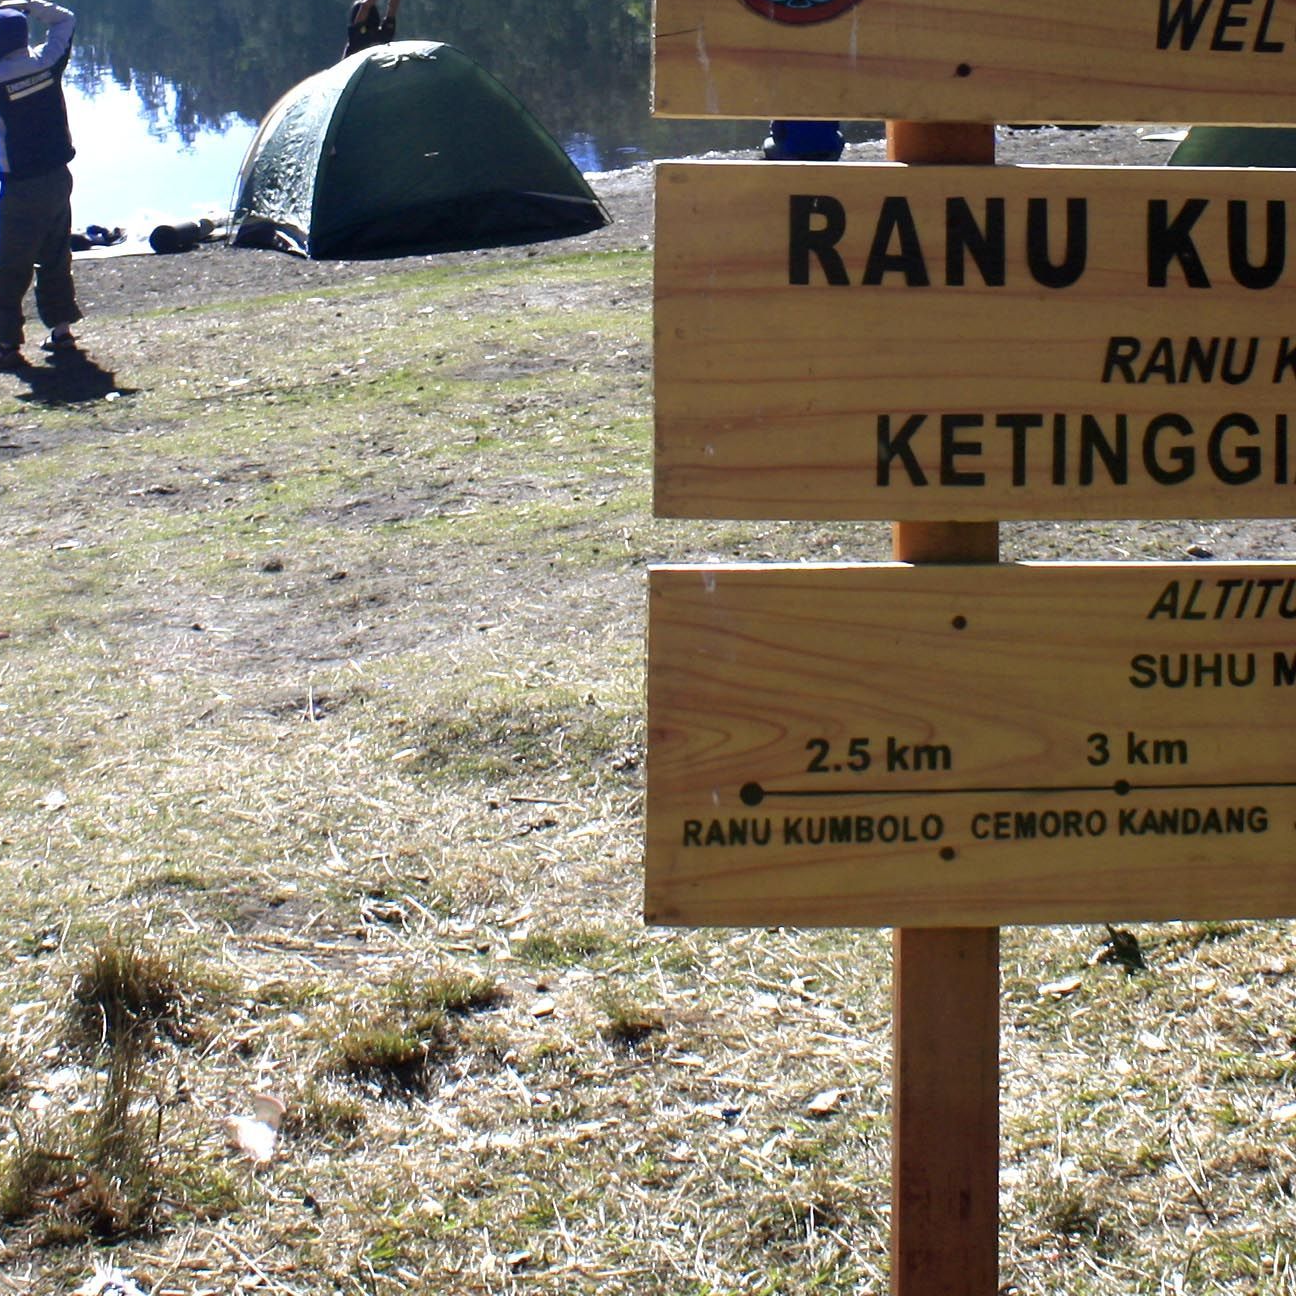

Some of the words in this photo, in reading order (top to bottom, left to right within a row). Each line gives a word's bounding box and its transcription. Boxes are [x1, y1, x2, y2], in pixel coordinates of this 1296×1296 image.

[788, 194, 1088, 290] RANU
[1101, 336, 1260, 386] RANU
[1129, 652, 1256, 689] SUHU
[805, 737, 872, 773] 2.5
[886, 736, 952, 773] km
[1087, 732, 1110, 767] 3
[1127, 731, 1188, 765] km
[682, 818, 772, 847] RANU
[782, 813, 945, 845] KUMBOLO
[970, 809, 1107, 841] CEMORO
[1118, 805, 1268, 836] KANDANG
